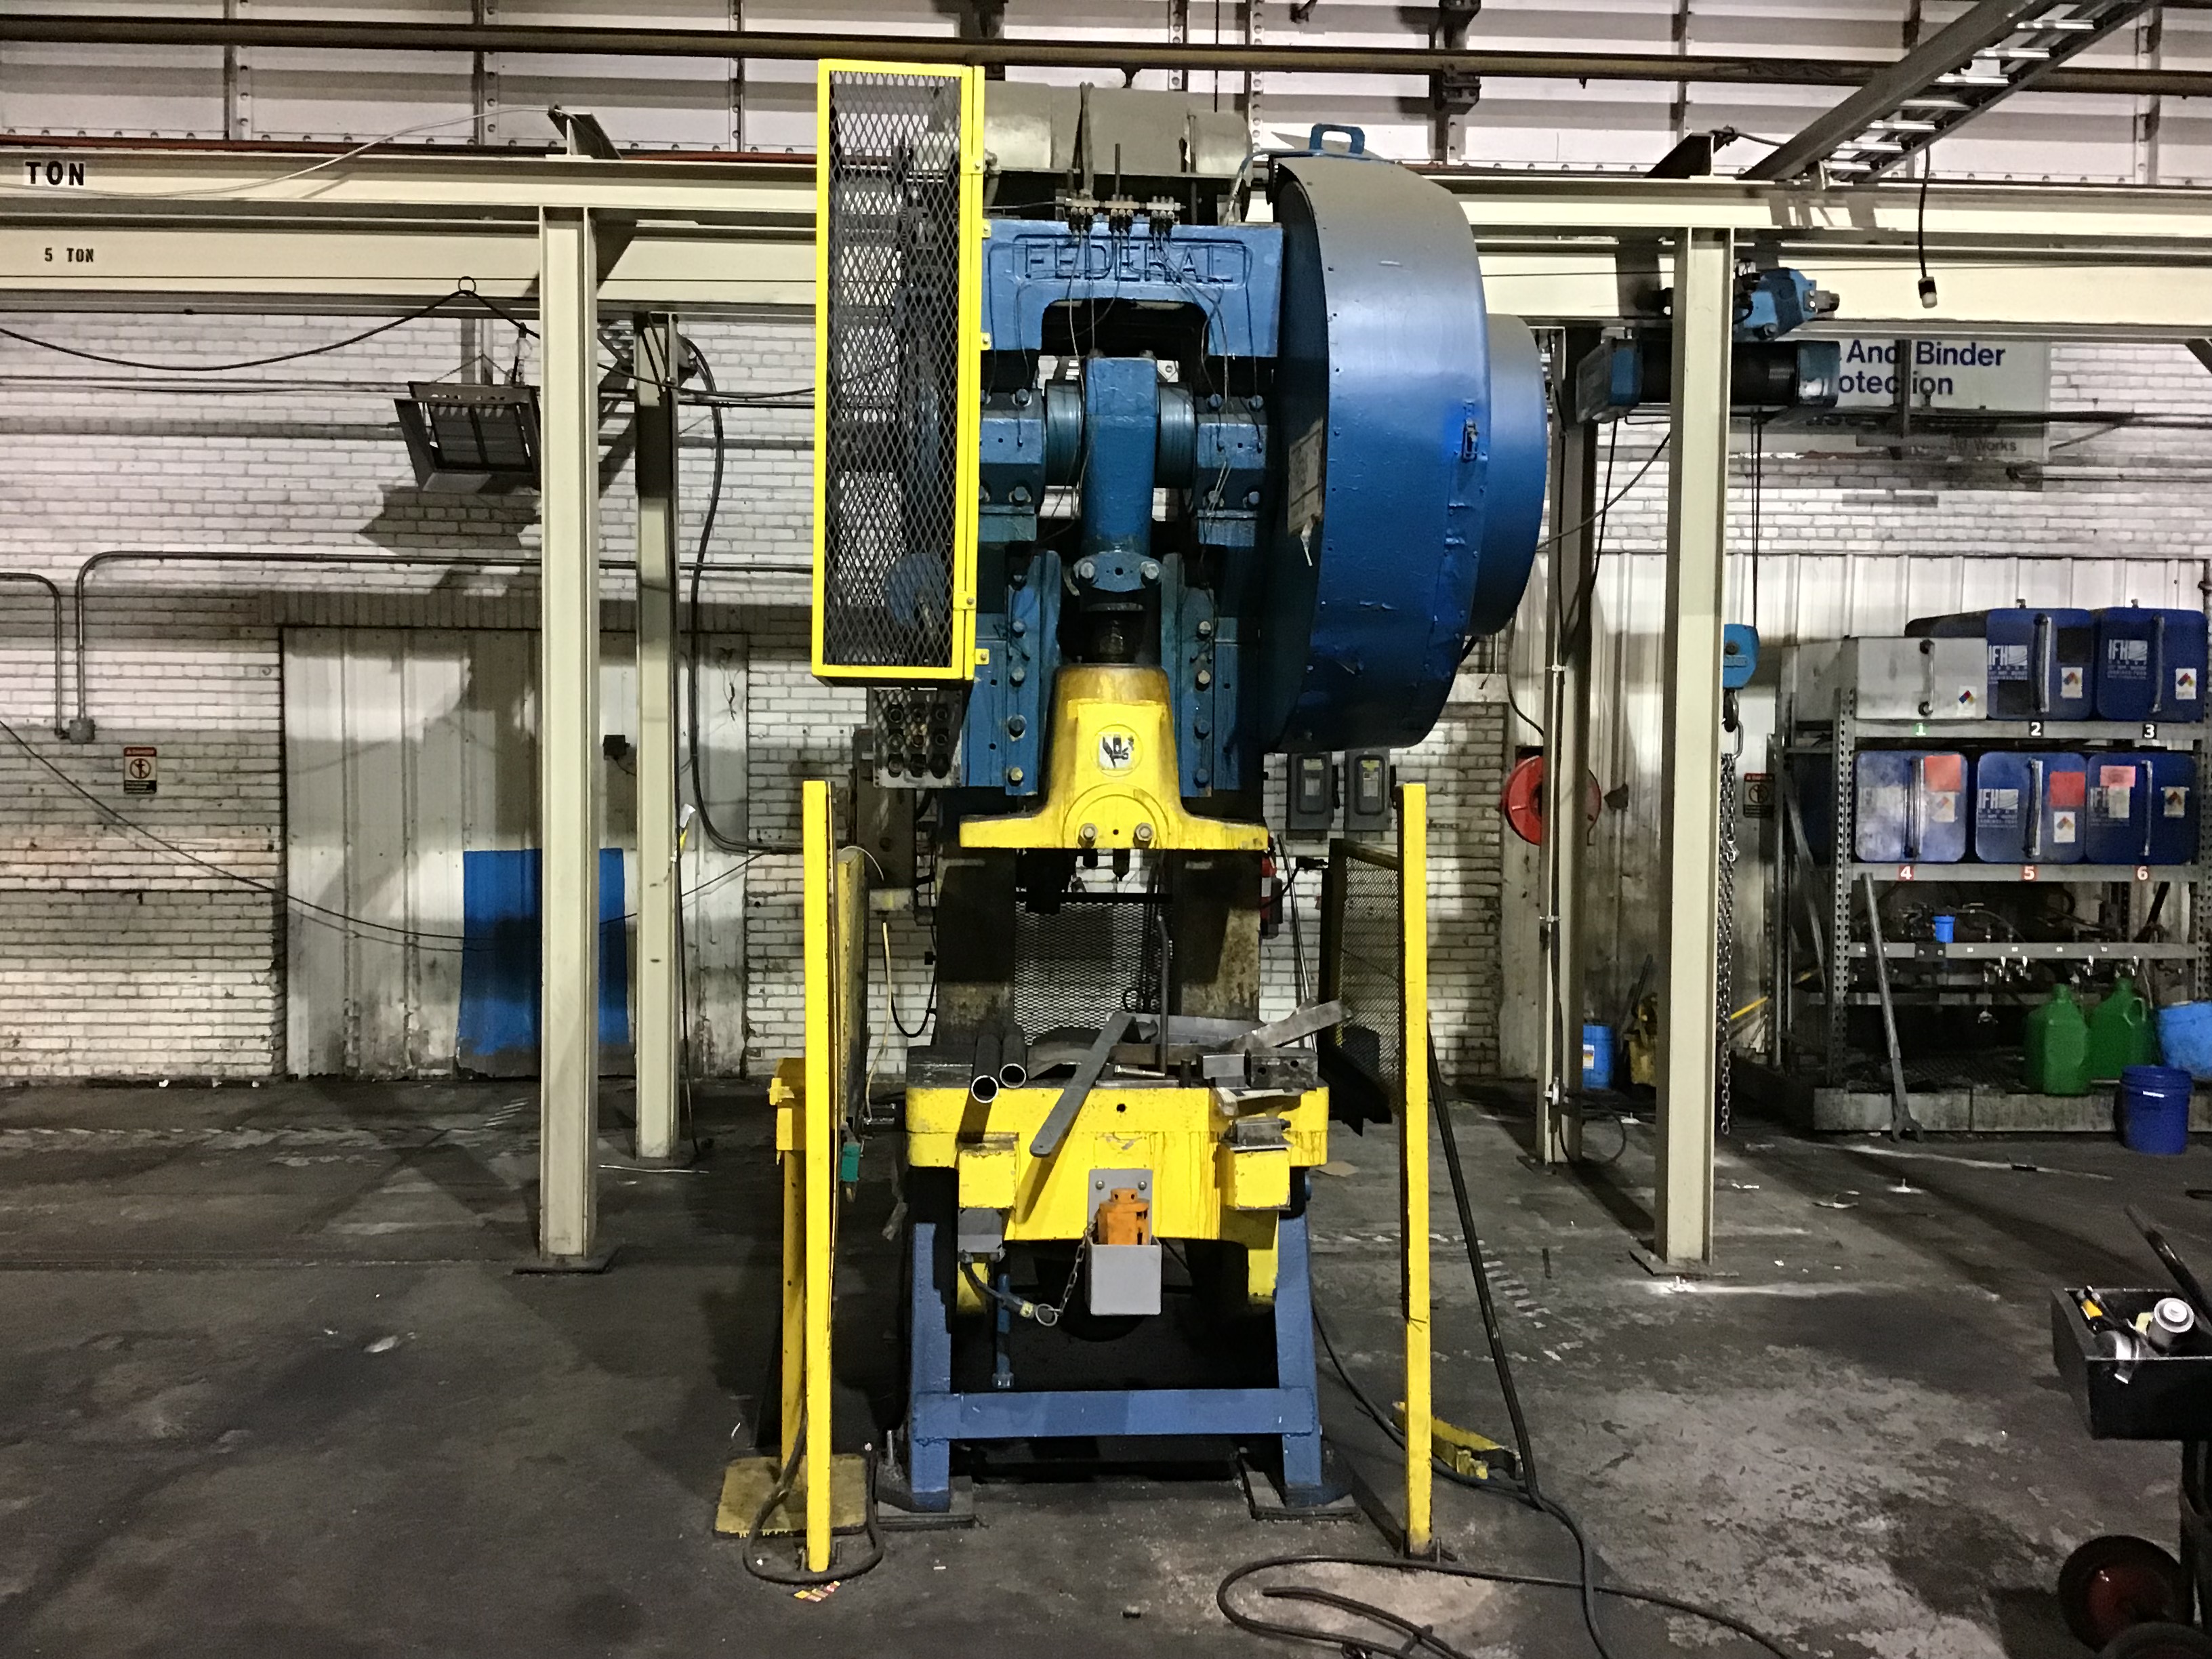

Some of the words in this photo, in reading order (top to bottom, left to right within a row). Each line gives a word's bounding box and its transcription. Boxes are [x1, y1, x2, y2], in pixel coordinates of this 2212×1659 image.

[25, 161, 85, 186] TON
[44, 247, 53, 262] 5
[66, 247, 94, 263] TON
[1025, 240, 1234, 284] FEDERAL
[1916, 341, 2006, 366] Binder
[1988, 645, 2008, 665] IFH
[2108, 639, 2129, 660] IFH
[1915, 724, 1925, 737] 1
[2030, 722, 2041, 737] 2
[2144, 724, 2155, 738] 3
[1978, 788, 1999, 809] IFH
[1900, 866, 1912, 880] 4
[2024, 866, 2034, 880] 5
[2137, 866, 2148, 880] 6
